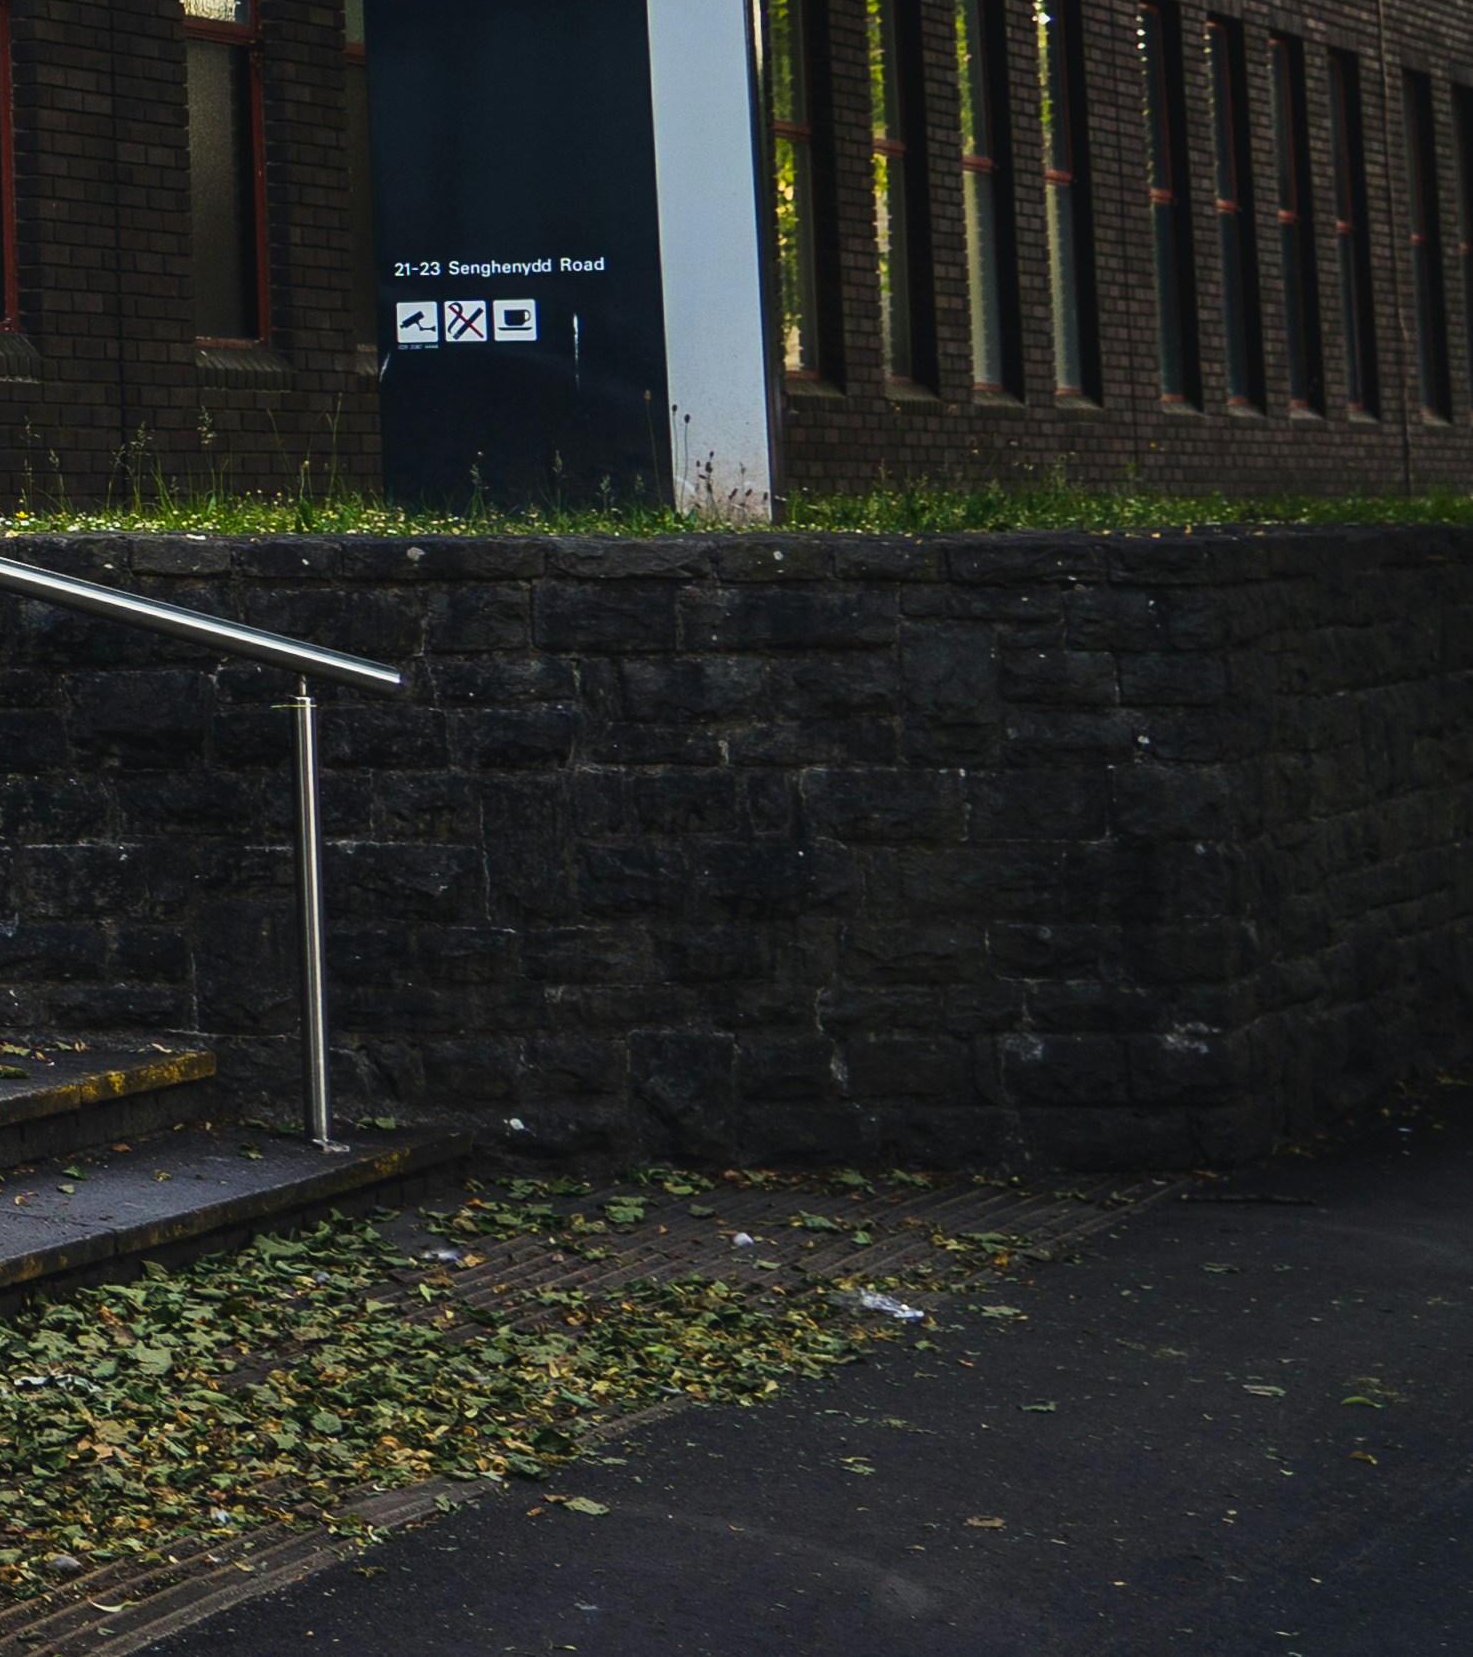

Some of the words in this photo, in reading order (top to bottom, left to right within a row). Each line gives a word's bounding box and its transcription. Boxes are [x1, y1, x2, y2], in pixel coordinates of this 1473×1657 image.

[394, 261, 441, 277] 21-23
[448, 258, 552, 277] Senghenydd
[560, 256, 606, 272] Road
